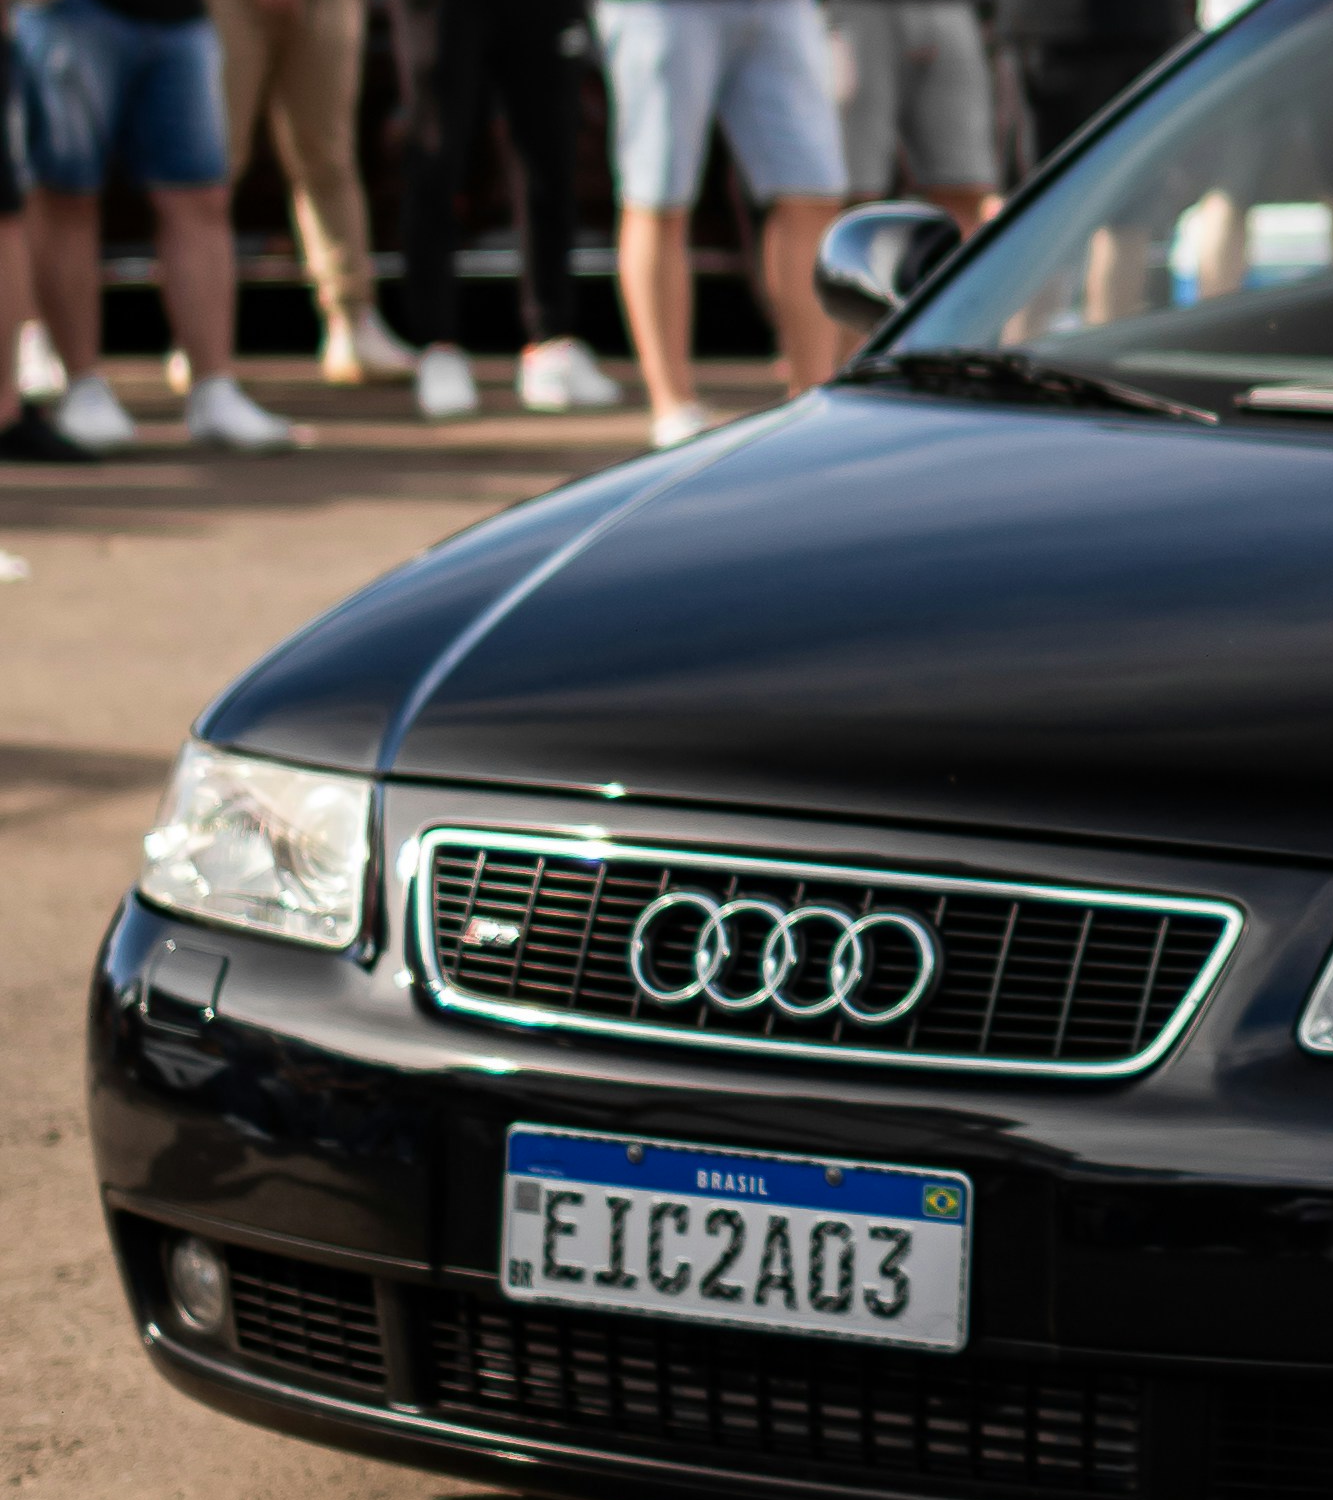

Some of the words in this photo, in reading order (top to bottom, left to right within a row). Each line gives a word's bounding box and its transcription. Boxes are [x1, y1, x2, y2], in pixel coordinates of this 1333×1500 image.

[695, 1167, 769, 1197] BRASIL
[543, 1190, 913, 1320] EIC2A03
[508, 1257, 535, 1289] BR
